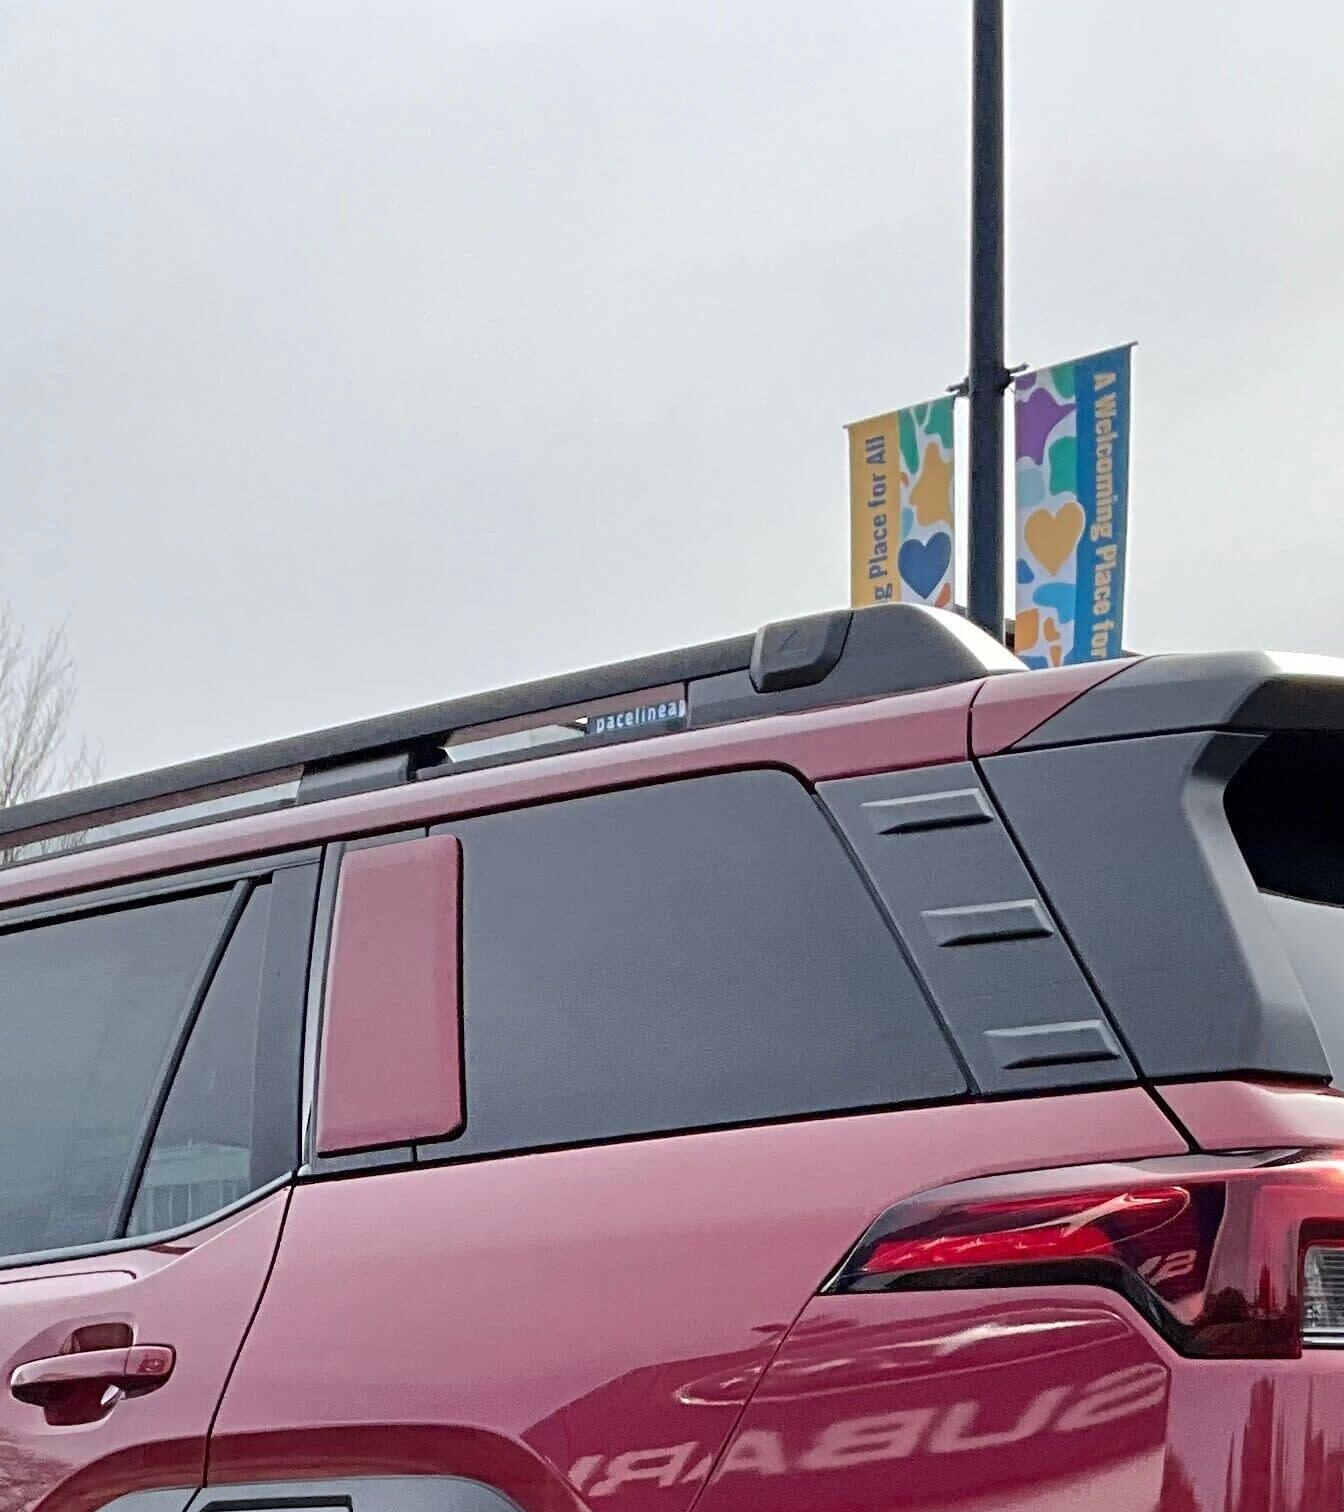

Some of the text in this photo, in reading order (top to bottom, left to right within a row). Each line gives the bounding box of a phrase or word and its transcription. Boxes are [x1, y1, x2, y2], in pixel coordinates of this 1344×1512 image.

[1093, 372, 1117, 391] A
[865, 435, 886, 465] All
[1089, 393, 1118, 541] Welcoming
[867, 473, 887, 509] for
[868, 513, 889, 579] Place
[1092, 544, 1118, 616] Place
